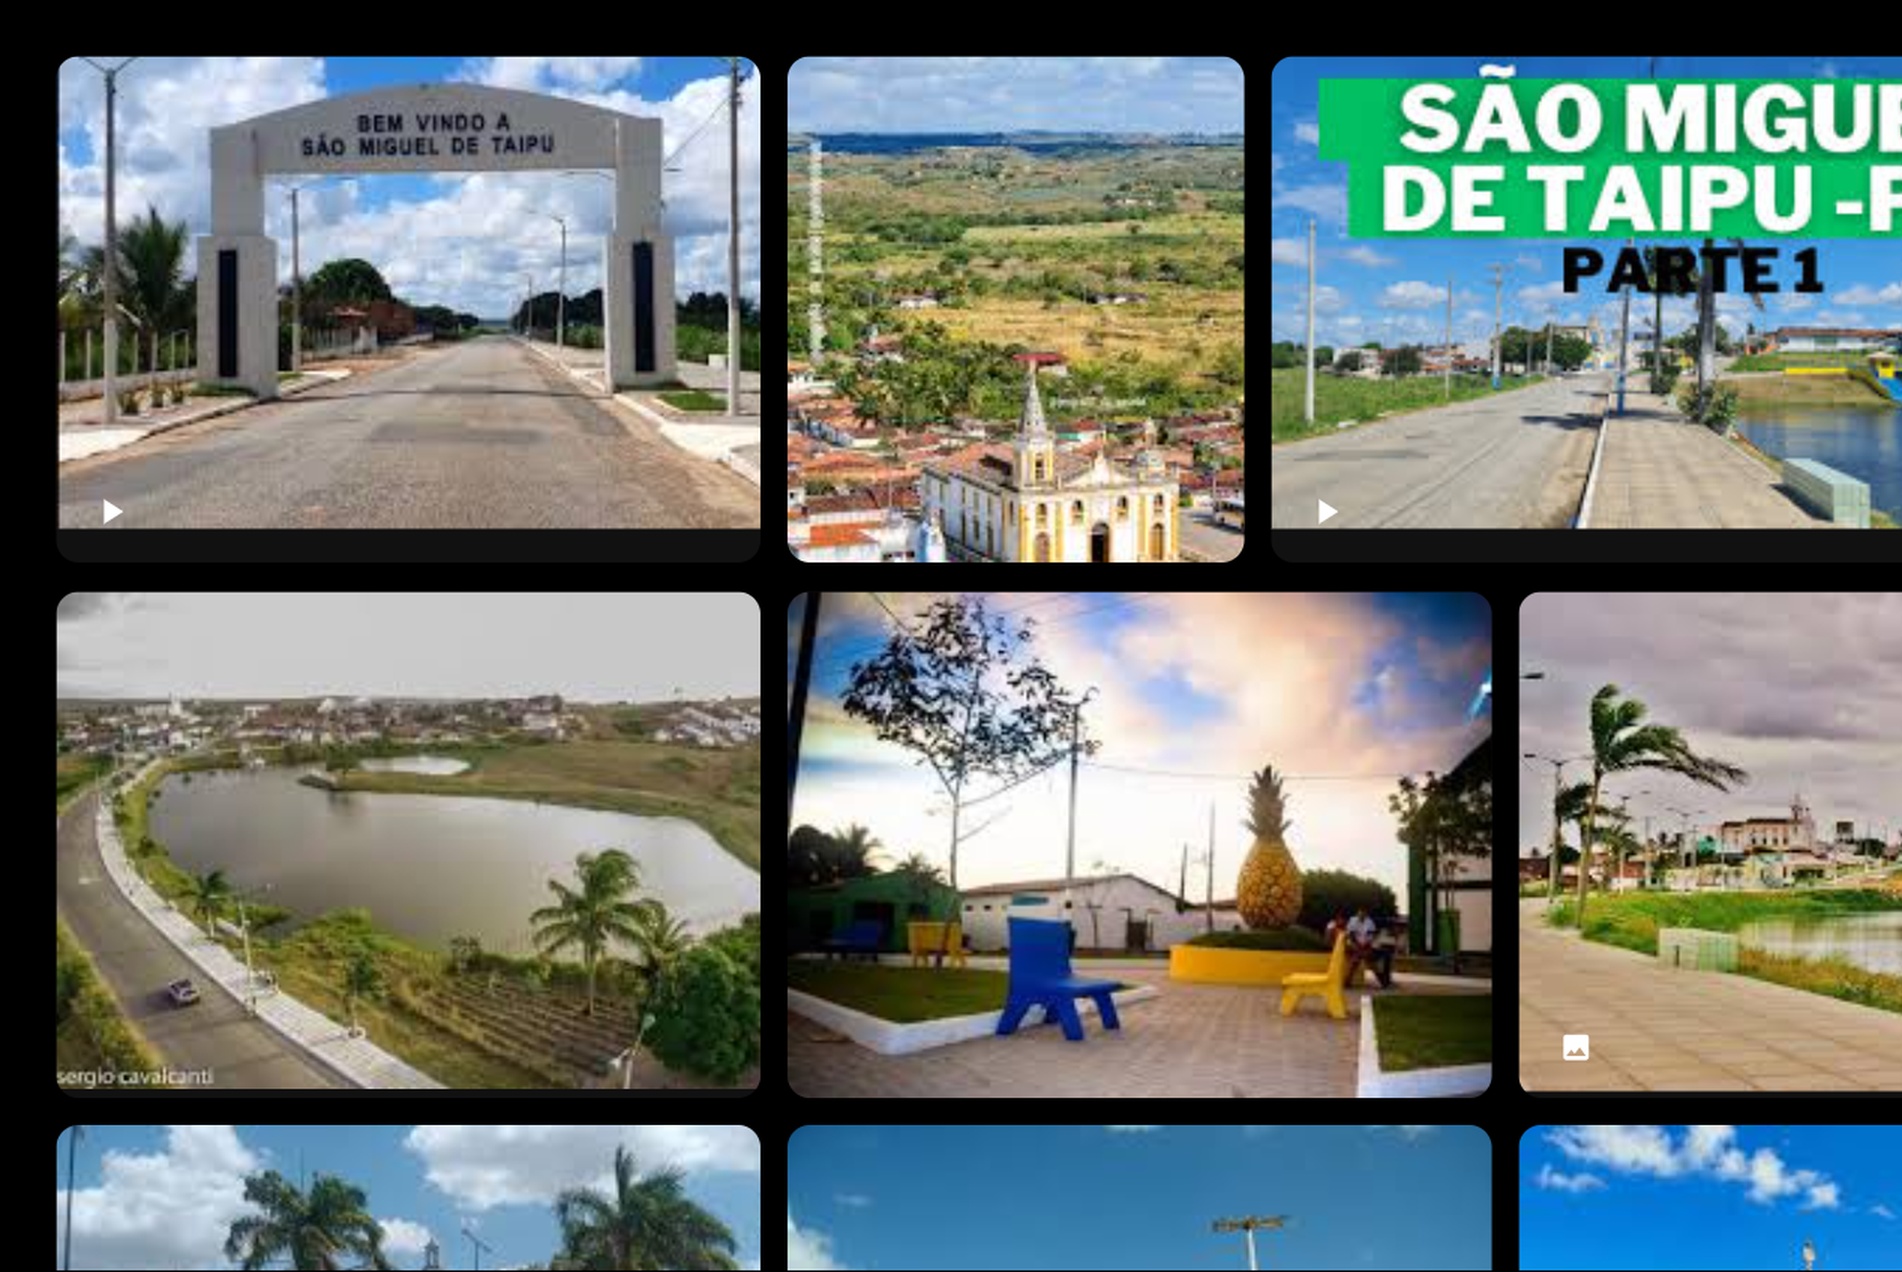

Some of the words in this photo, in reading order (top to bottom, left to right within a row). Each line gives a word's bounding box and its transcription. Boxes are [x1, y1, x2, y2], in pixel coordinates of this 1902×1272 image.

[357, 114, 403, 133] BEM
[416, 114, 486, 132] VINDO
[496, 113, 511, 131] A
[302, 133, 346, 156] SÃO
[359, 137, 440, 156] MIGUEL
[452, 137, 480, 155] DE
[492, 135, 556, 154] TAIPU
